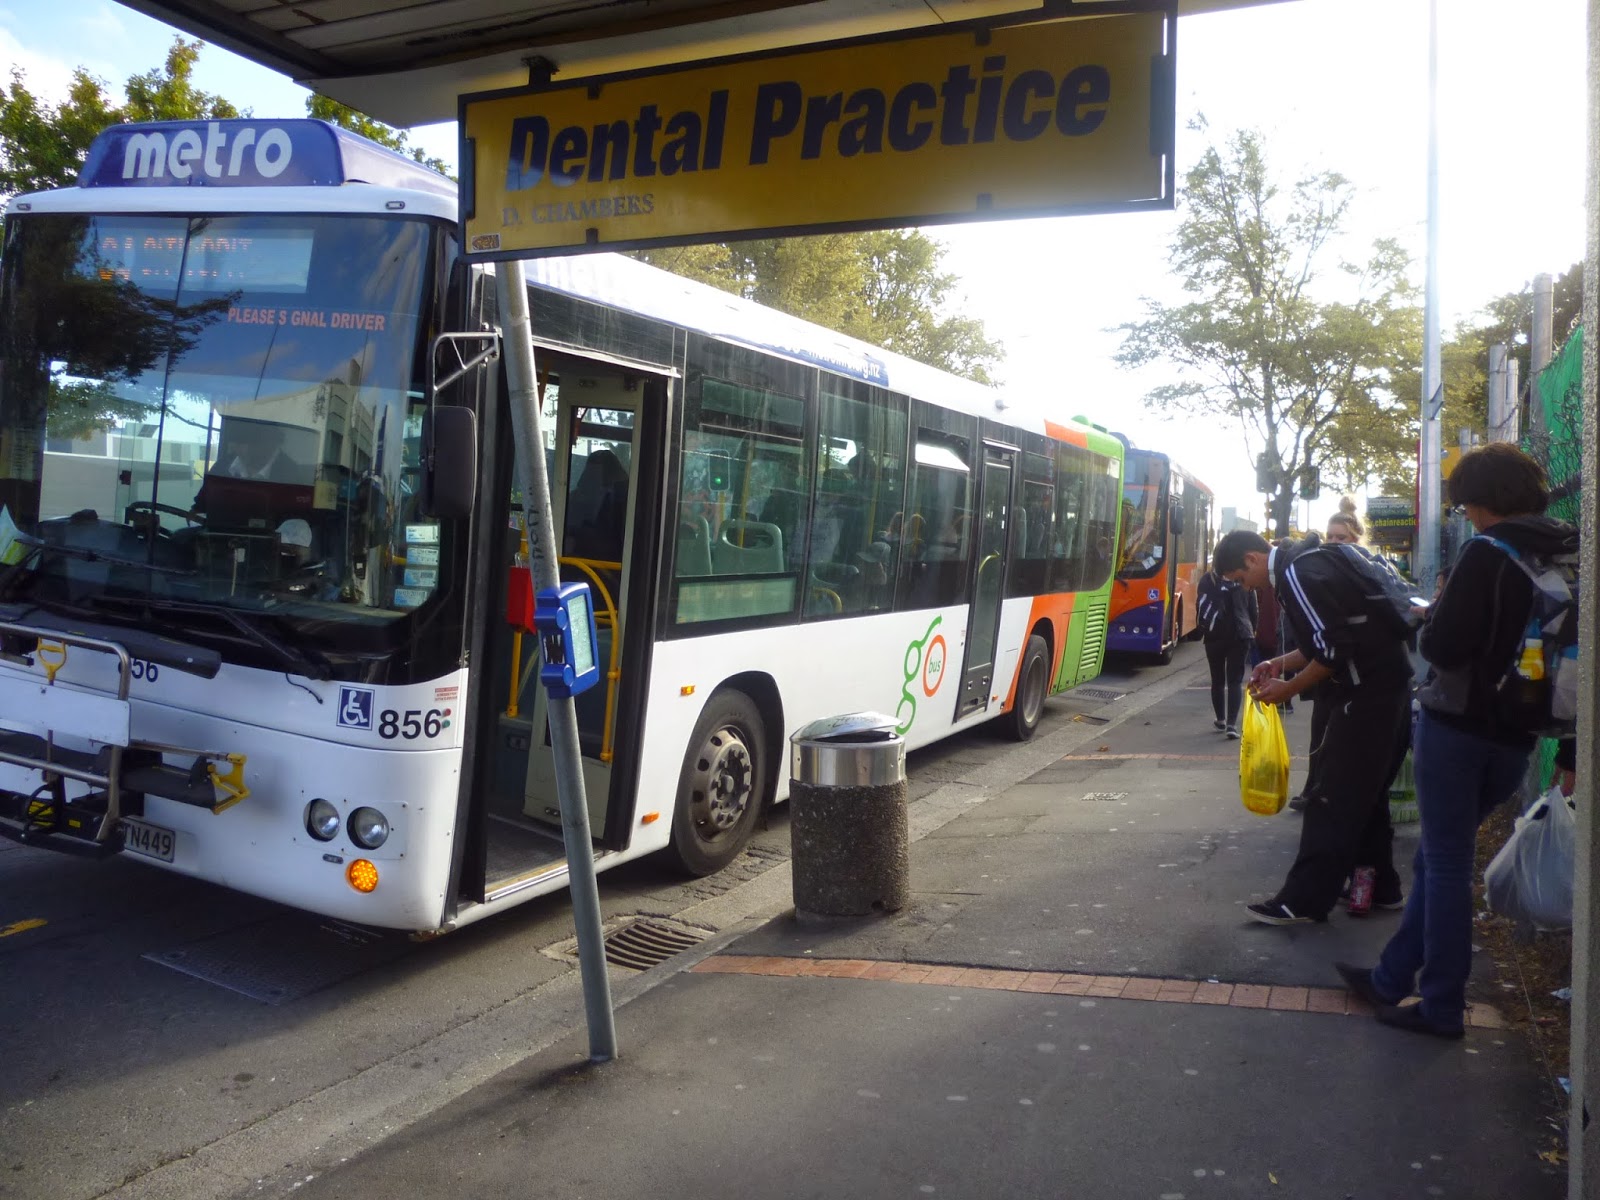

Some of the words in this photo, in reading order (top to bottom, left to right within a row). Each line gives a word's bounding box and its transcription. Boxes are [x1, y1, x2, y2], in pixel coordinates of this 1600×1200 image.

[505, 89, 731, 193] Dental
[749, 54, 1112, 166] Practice
[123, 122, 292, 178] metro
[501, 207, 522, 228] D.
[530, 193, 655, 224] CHAMBERS
[227, 307, 276, 325] PLEASE
[330, 312, 386, 331] DRIVER
[118, 657, 159, 683] 56
[928, 655, 942, 674] bus
[378, 708, 442, 740] 856
